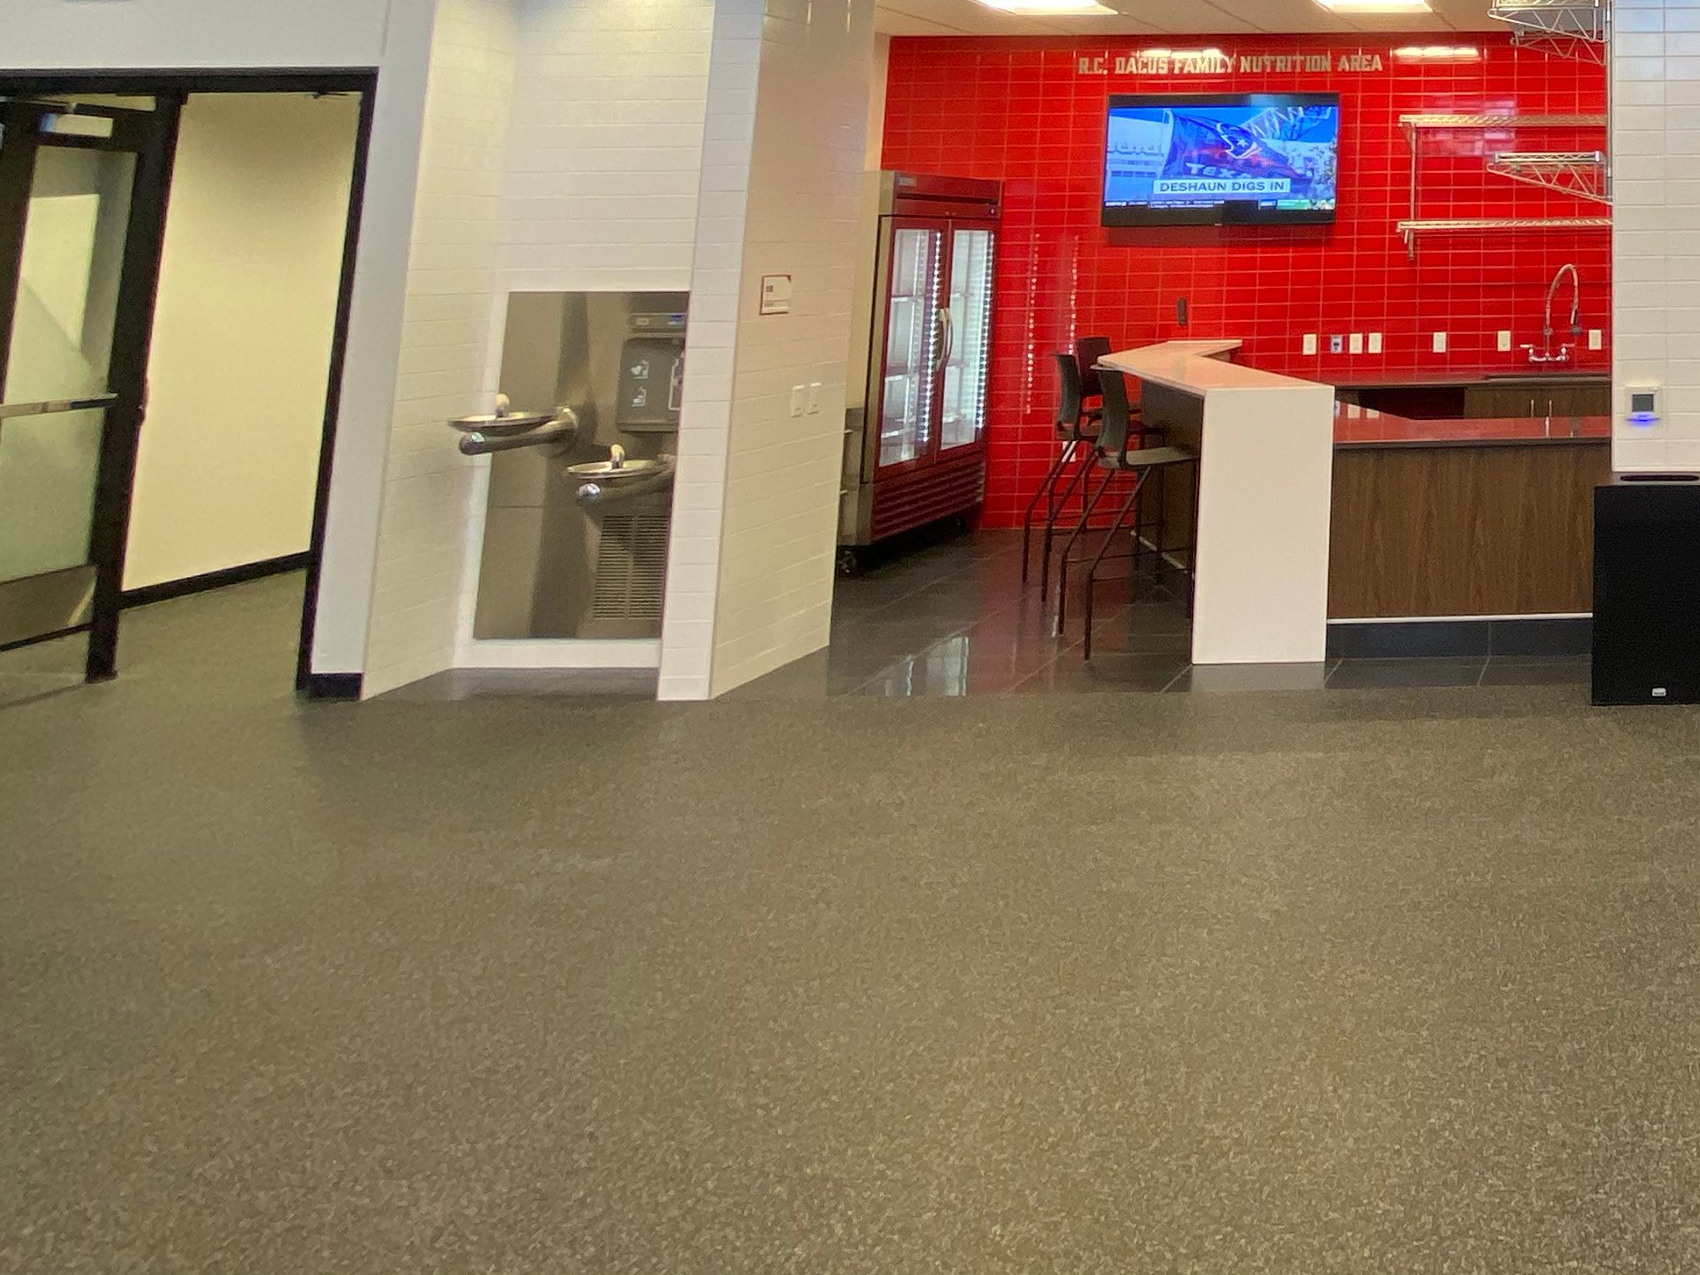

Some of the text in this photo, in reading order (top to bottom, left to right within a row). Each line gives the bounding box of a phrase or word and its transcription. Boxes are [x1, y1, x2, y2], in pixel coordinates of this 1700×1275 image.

[1173, 55, 1233, 74] FAMILY
[1240, 55, 1332, 72] NUTRITION
[1337, 54, 1383, 71] AREA
[1160, 181, 1284, 192] DESHAUN DIGS IN
